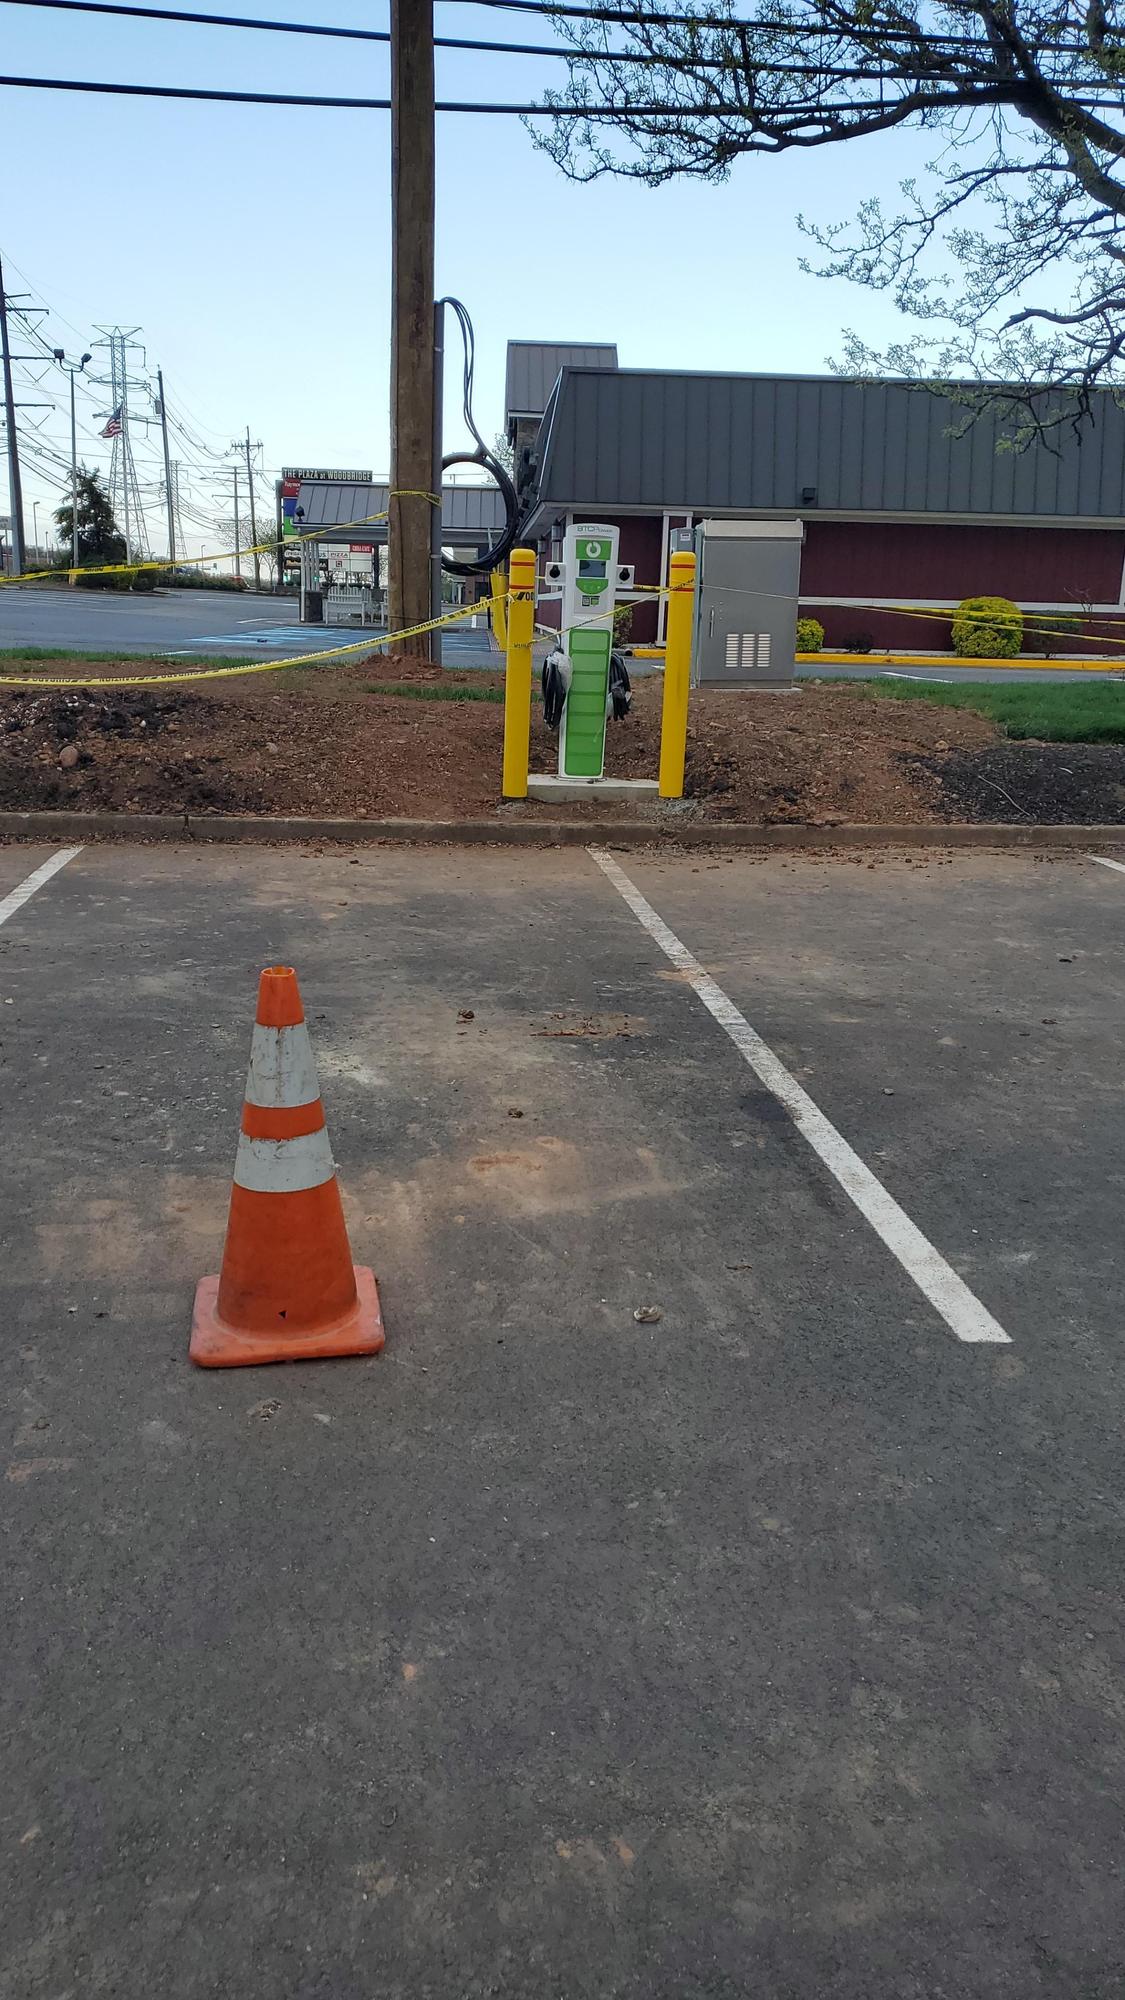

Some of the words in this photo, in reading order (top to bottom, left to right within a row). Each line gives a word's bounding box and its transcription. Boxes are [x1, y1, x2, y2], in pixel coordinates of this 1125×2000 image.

[284, 469, 296, 478] THE
[299, 470, 319, 479] PLAZA
[328, 470, 371, 481] WOODBRIDGE
